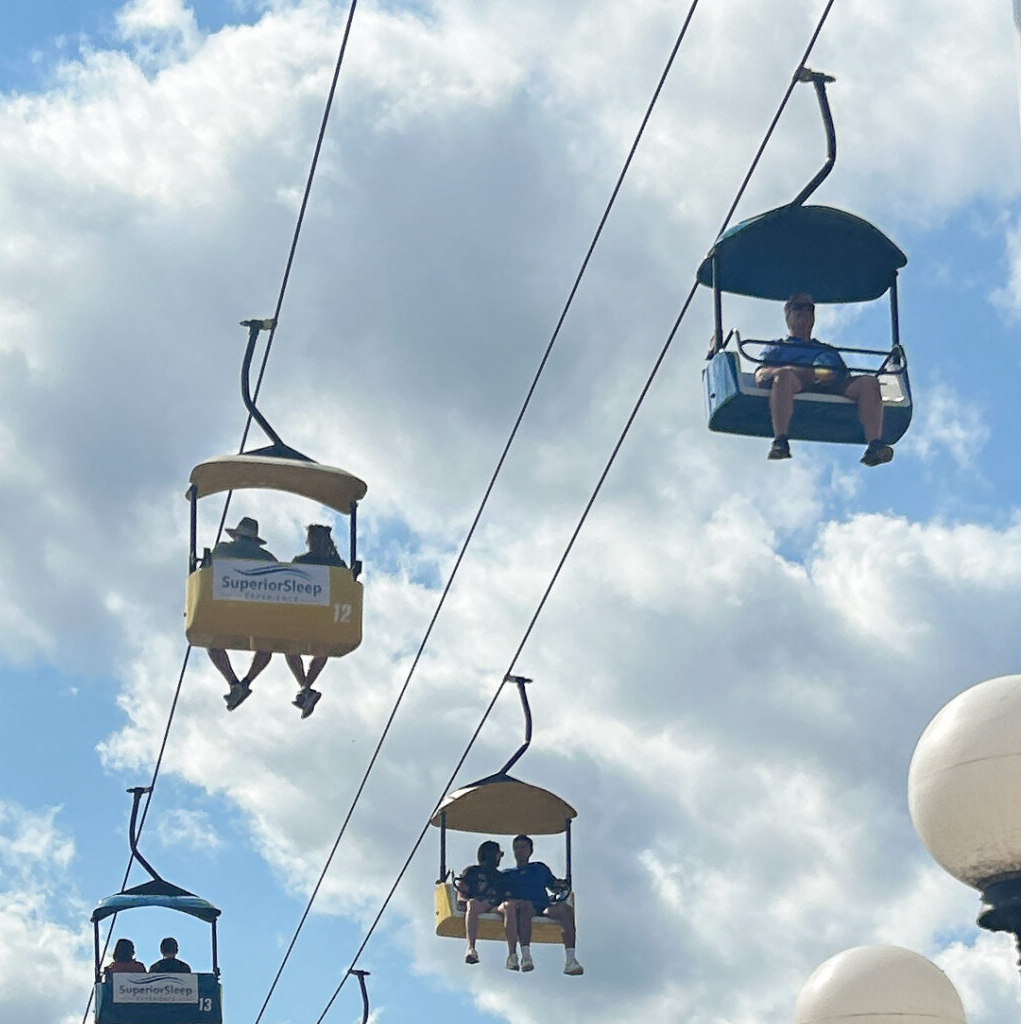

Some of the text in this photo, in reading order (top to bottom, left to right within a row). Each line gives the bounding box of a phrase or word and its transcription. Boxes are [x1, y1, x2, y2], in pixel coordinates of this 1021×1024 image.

[221, 576, 323, 597] SuperiorSleep
[333, 603, 352, 623] 12
[119, 984, 193, 997] SuperiorSleep
[198, 997, 212, 1012] 13
